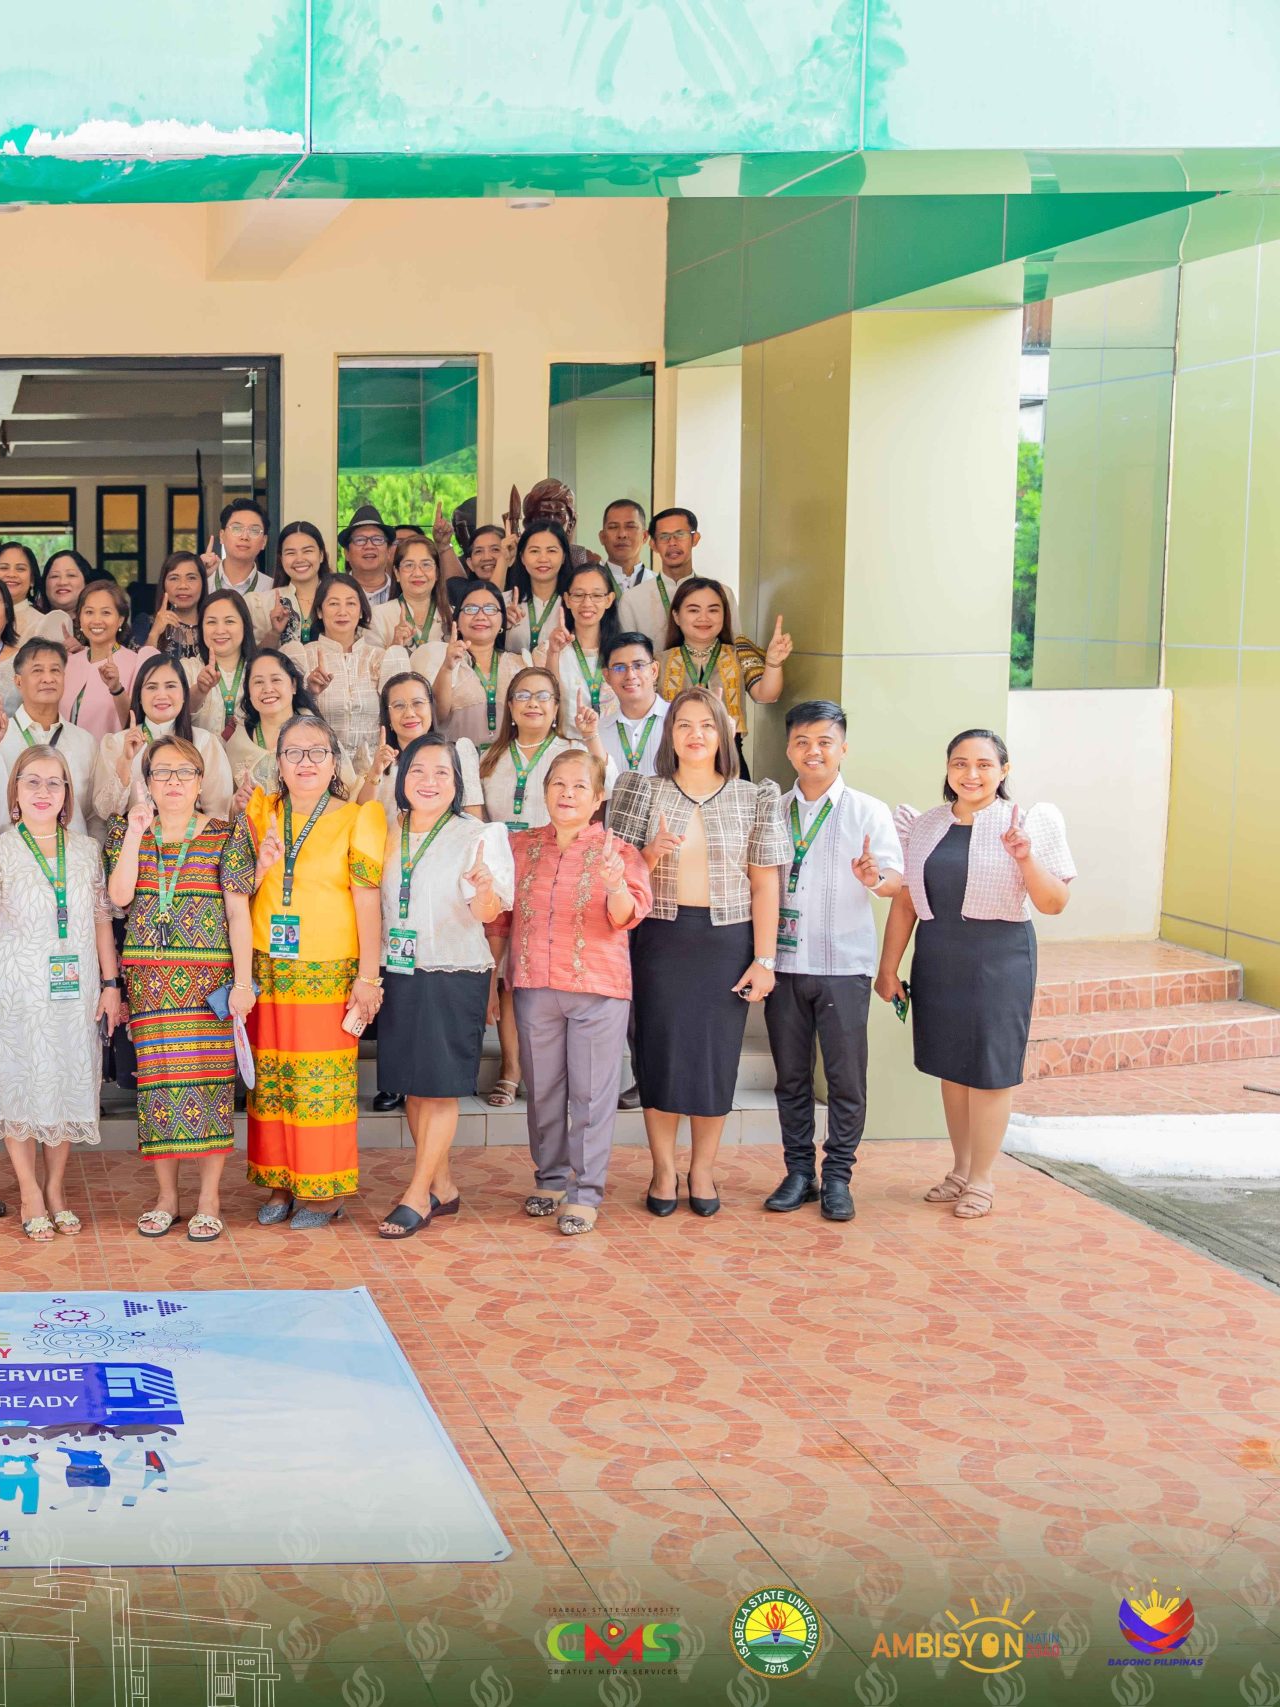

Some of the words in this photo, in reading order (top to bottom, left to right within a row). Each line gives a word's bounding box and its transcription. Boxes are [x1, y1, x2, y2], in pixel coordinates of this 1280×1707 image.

[21, 830, 40, 856] ECHAGUE
[289, 835, 306, 859] ISABELA
[300, 820, 314, 837] STATE
[309, 793, 330, 823] UNIVERSITY
